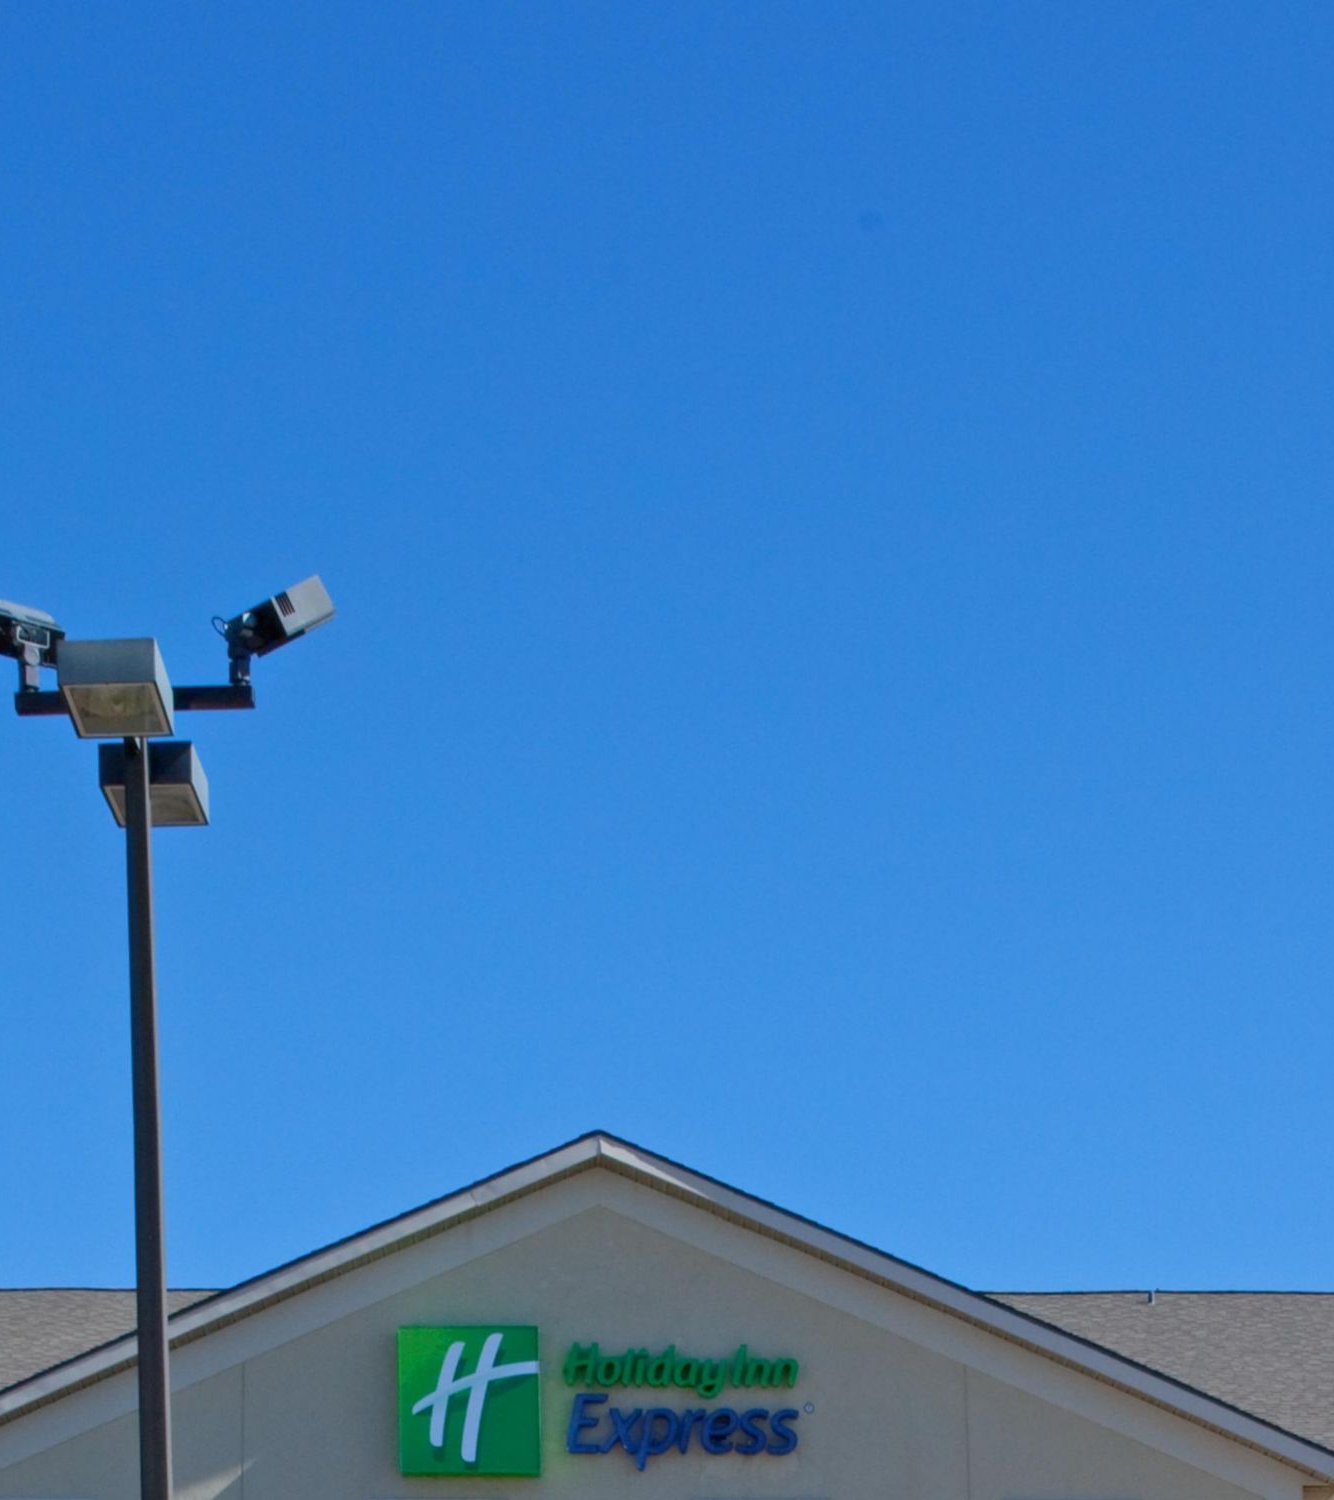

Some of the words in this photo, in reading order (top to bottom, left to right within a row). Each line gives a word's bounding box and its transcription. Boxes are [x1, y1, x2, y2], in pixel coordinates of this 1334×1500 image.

[563, 1342, 727, 1398] Holiday
[729, 1344, 800, 1388] Inn
[566, 1392, 800, 1472] Express
